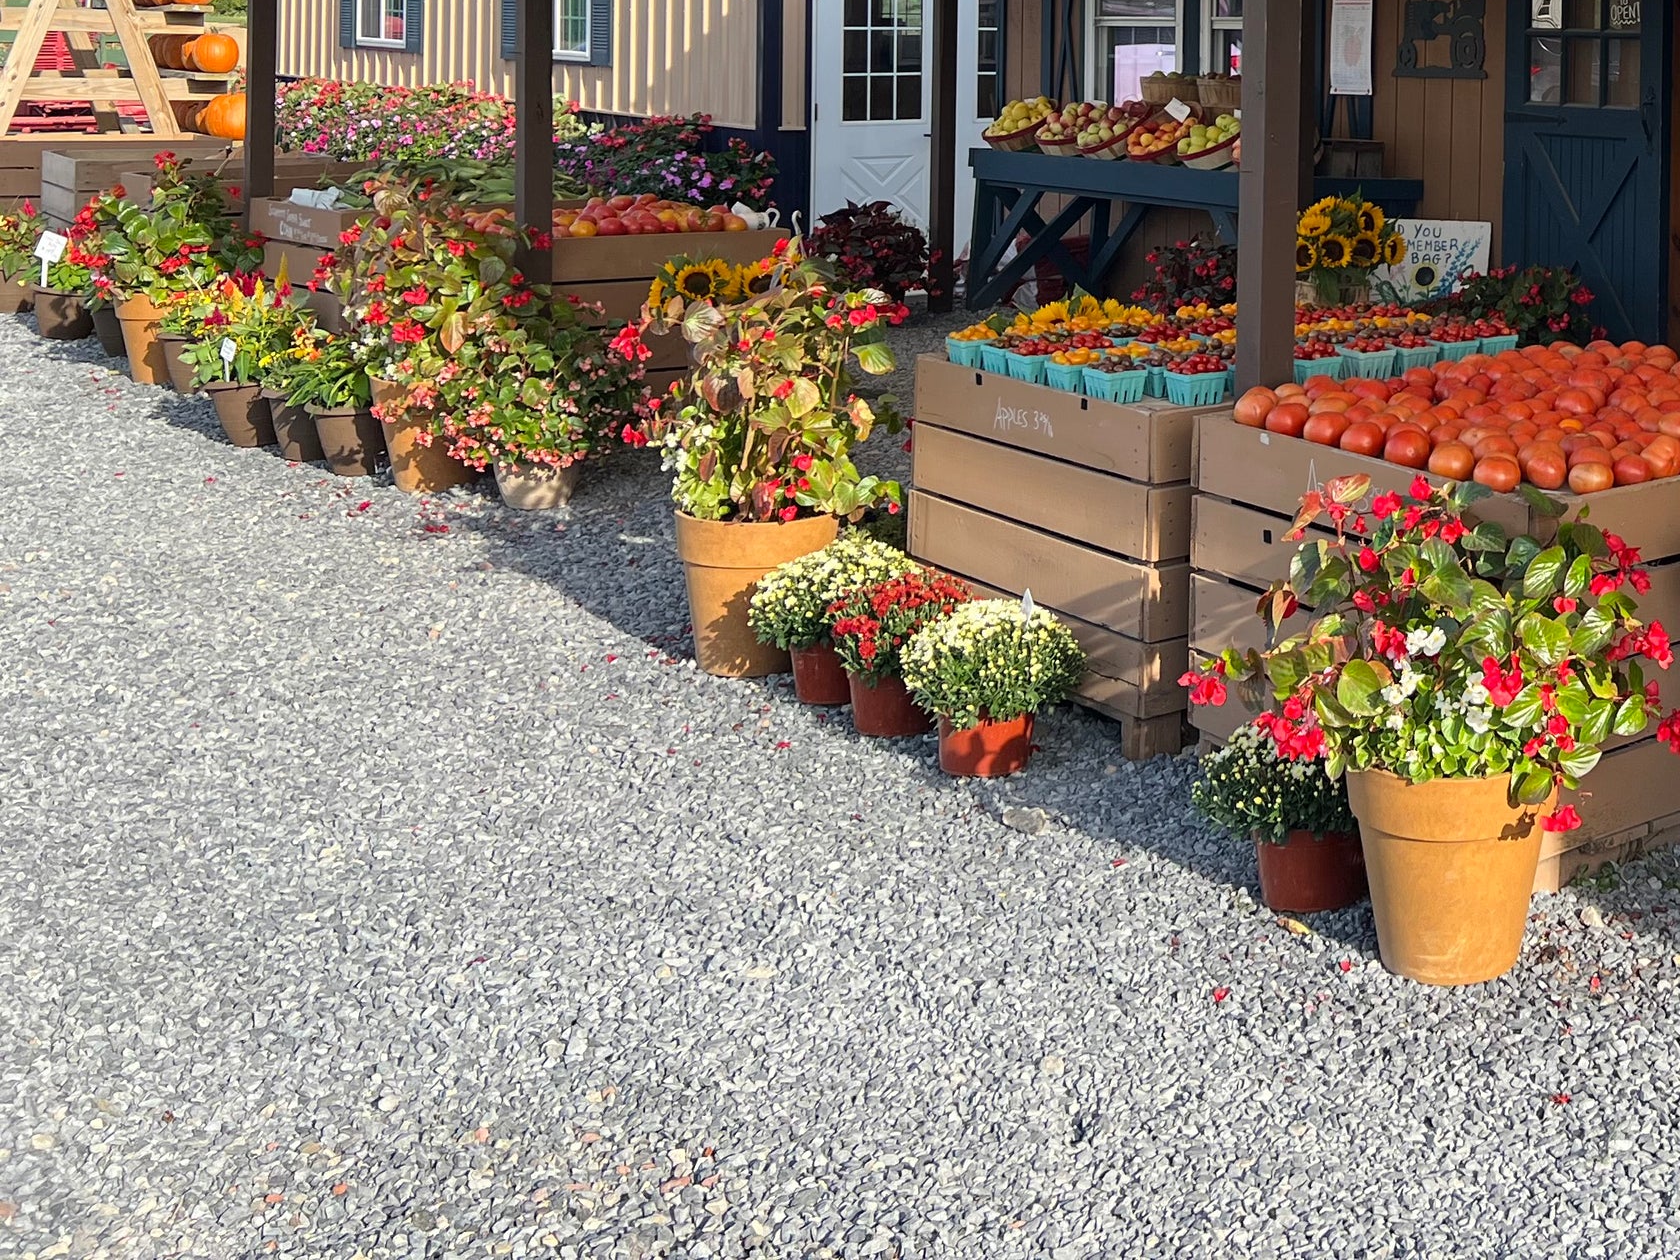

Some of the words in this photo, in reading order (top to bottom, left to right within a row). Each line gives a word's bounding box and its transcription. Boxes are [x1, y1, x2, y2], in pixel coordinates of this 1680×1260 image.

[1610, 2, 1641, 23] OPEN!
[1414, 223, 1442, 239] YOU
[1406, 238, 1460, 252] MEMBER
[993, 395, 1029, 431] APPLES
